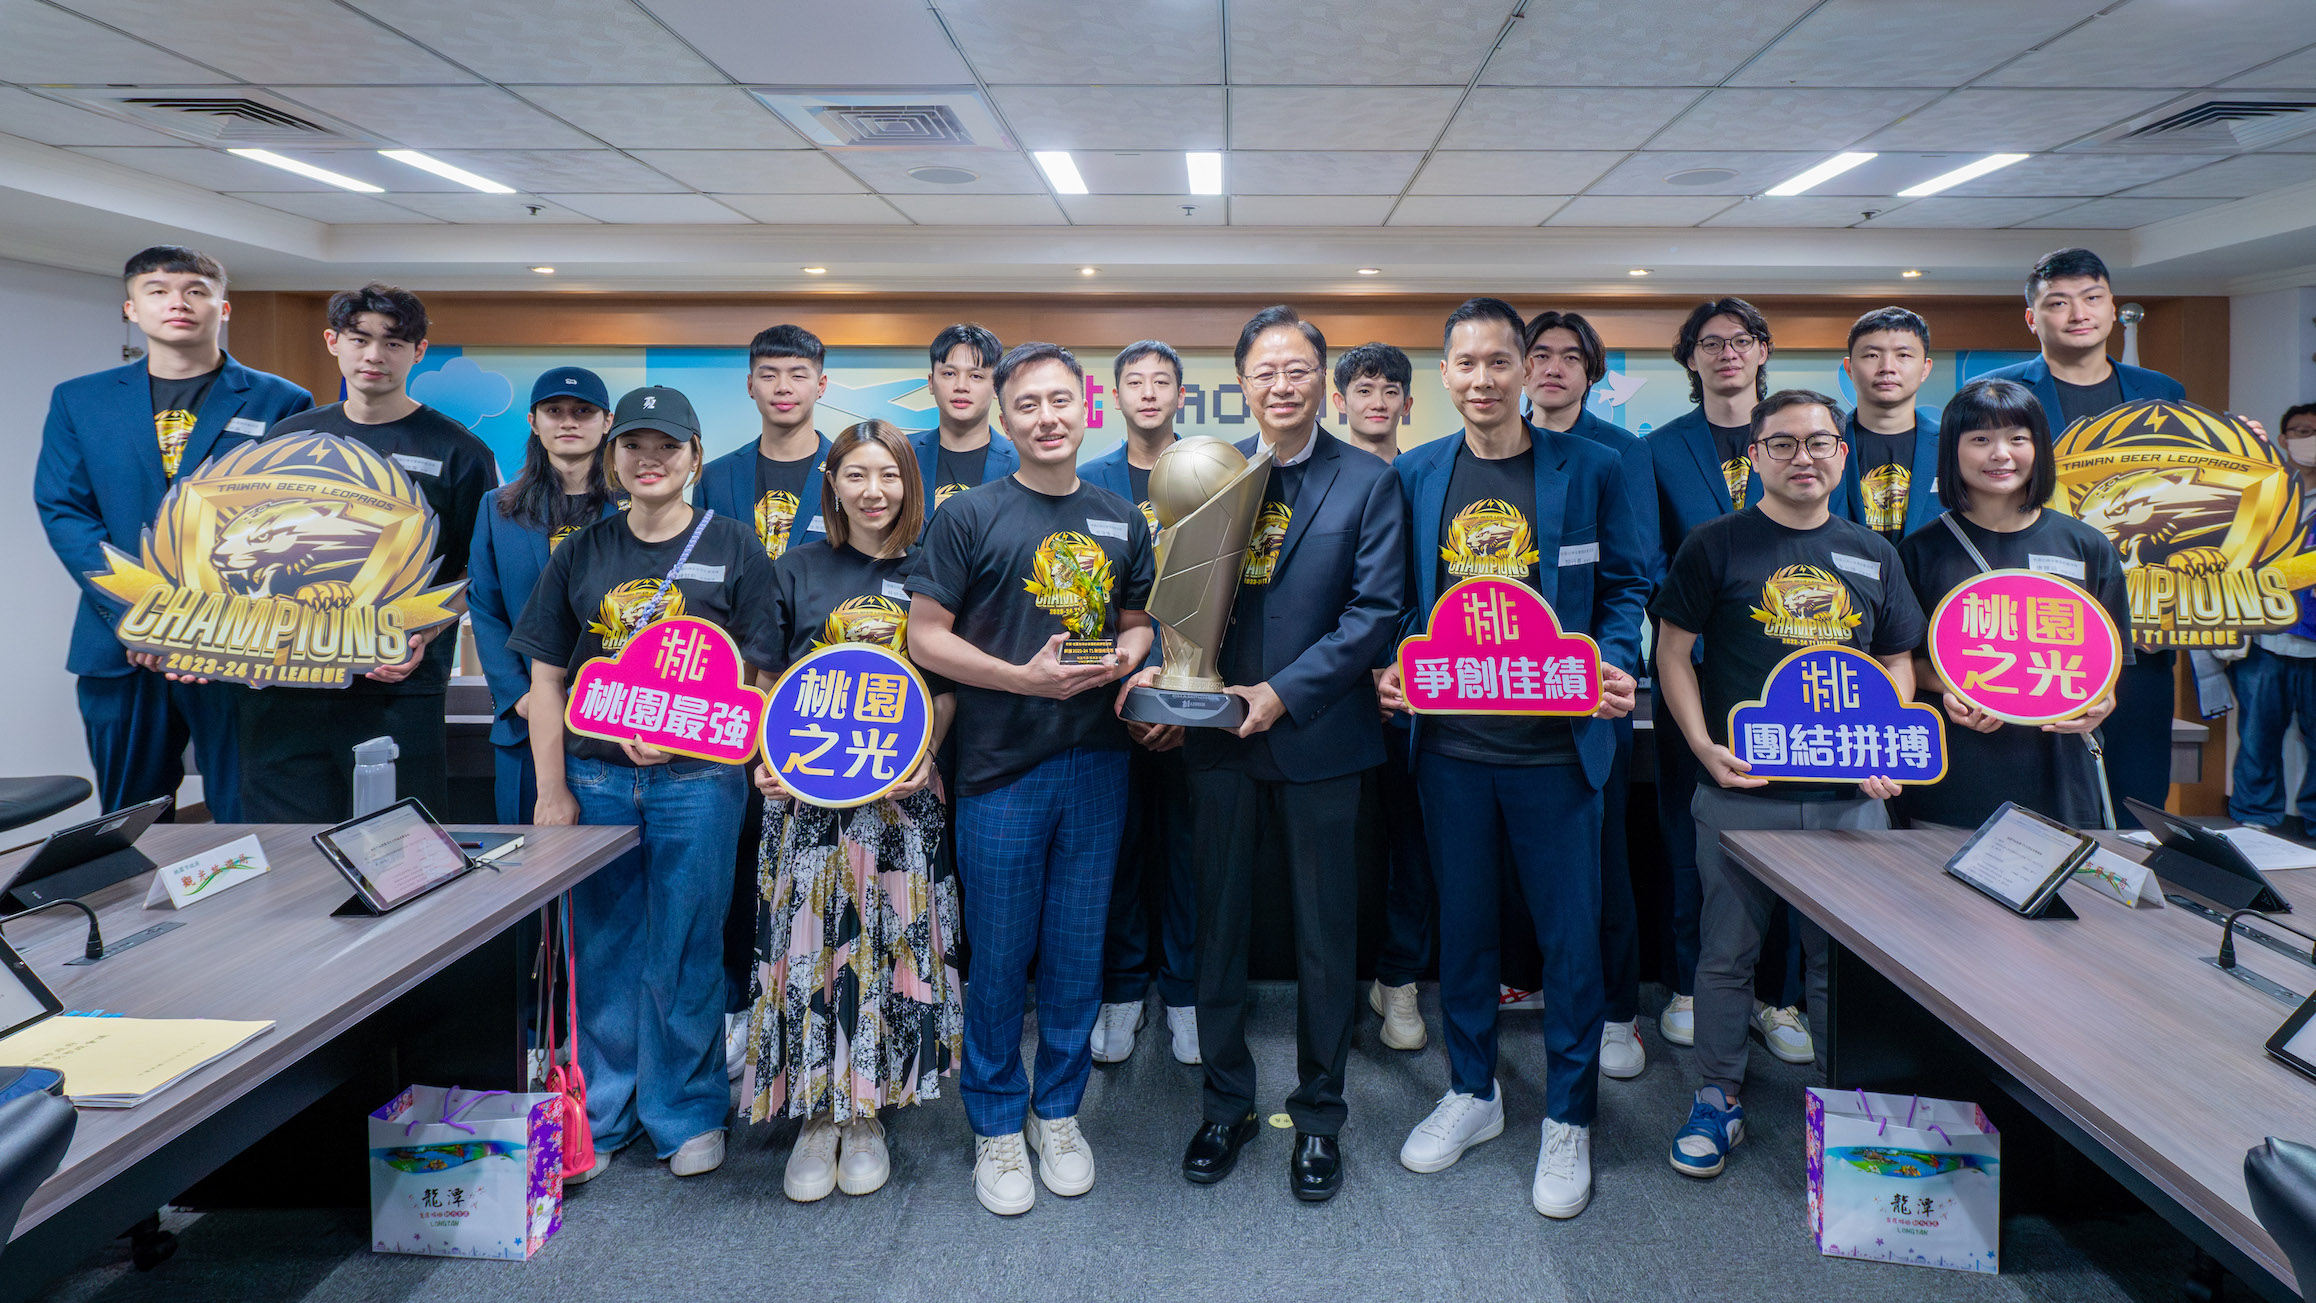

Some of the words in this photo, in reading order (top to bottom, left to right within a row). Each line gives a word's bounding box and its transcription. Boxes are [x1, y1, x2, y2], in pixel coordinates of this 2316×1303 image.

[2063, 456, 2114, 471] TAIWAN
[2121, 454, 2161, 463] BEER
[2167, 454, 2251, 473] LEOPARDS
[217, 482, 271, 493] TAIWAN
[276, 482, 317, 493] BEER
[321, 487, 396, 512] LEOPARDS
[1448, 555, 1530, 578] CHAMPIONS
[2125, 566, 2298, 626] MPIONS
[121, 584, 408, 665] CHAMPIONS
[1764, 616, 1853, 640] CHAMPIONS
[1961, 592, 2085, 647] 桃園
[2143, 629, 2163, 644] T1
[2169, 629, 2238, 645] LEAGUE
[165, 653, 248, 678] 2023-24
[253, 664, 275, 680] T1
[278, 663, 346, 684] LEAGUE
[1414, 656, 1590, 700] 爭創佳績
[1961, 644, 2088, 700] 之光
[579, 678, 751, 749] 桃園最強
[794, 667, 909, 724] 桃園
[781, 723, 899, 780] 之光
[1744, 723, 1932, 769] 團結拼搏
[422, 1187, 465, 1208] 龍潭
[1890, 1193, 1935, 1217] 龍潭
